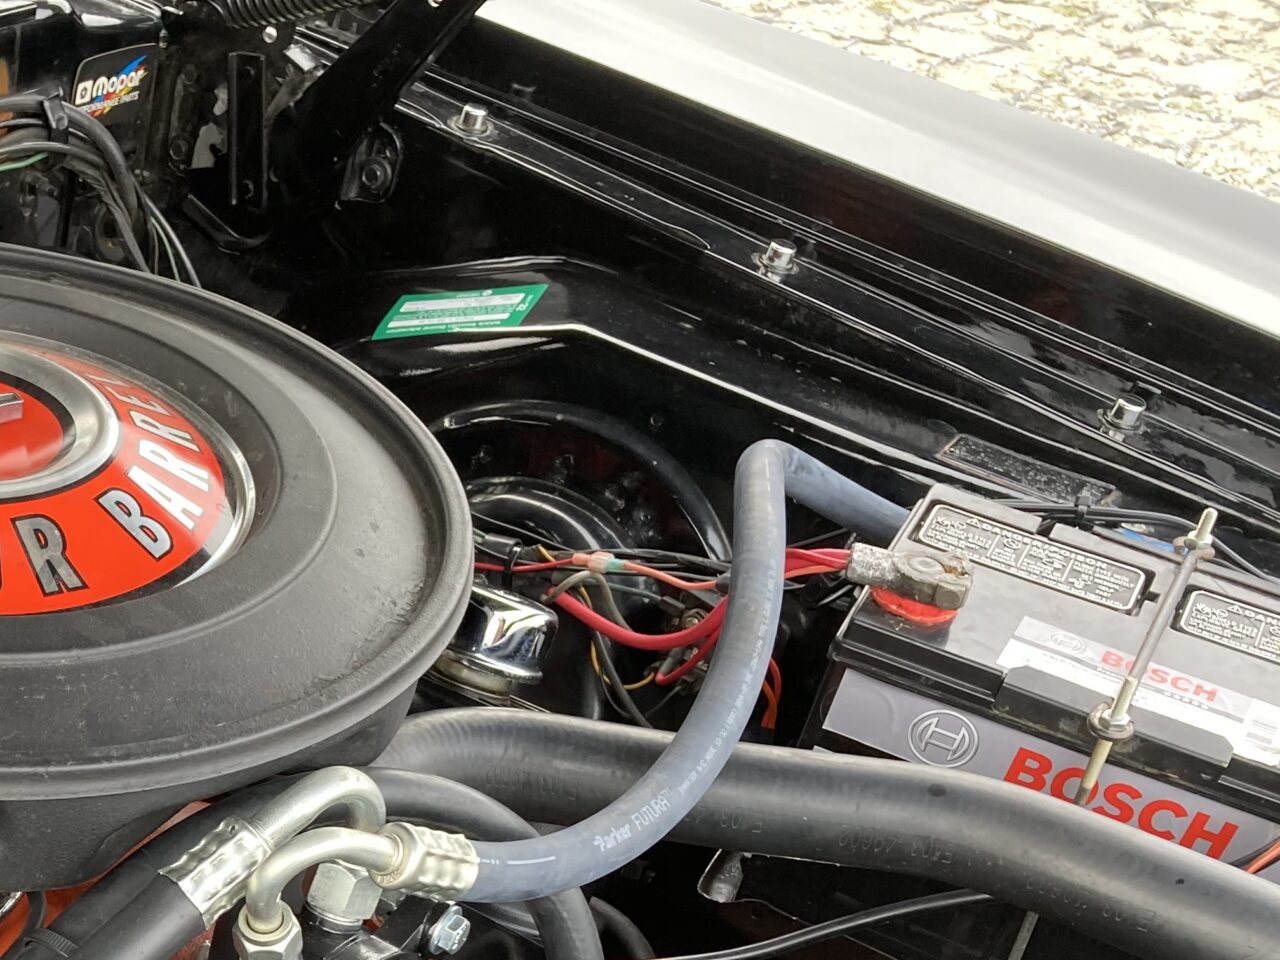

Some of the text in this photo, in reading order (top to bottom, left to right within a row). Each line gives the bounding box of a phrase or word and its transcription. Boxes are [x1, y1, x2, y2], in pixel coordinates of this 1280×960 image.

[92, 68, 146, 98] Mopar
[1004, 747, 1239, 861] BOSCH
[593, 823, 632, 852] Parker
